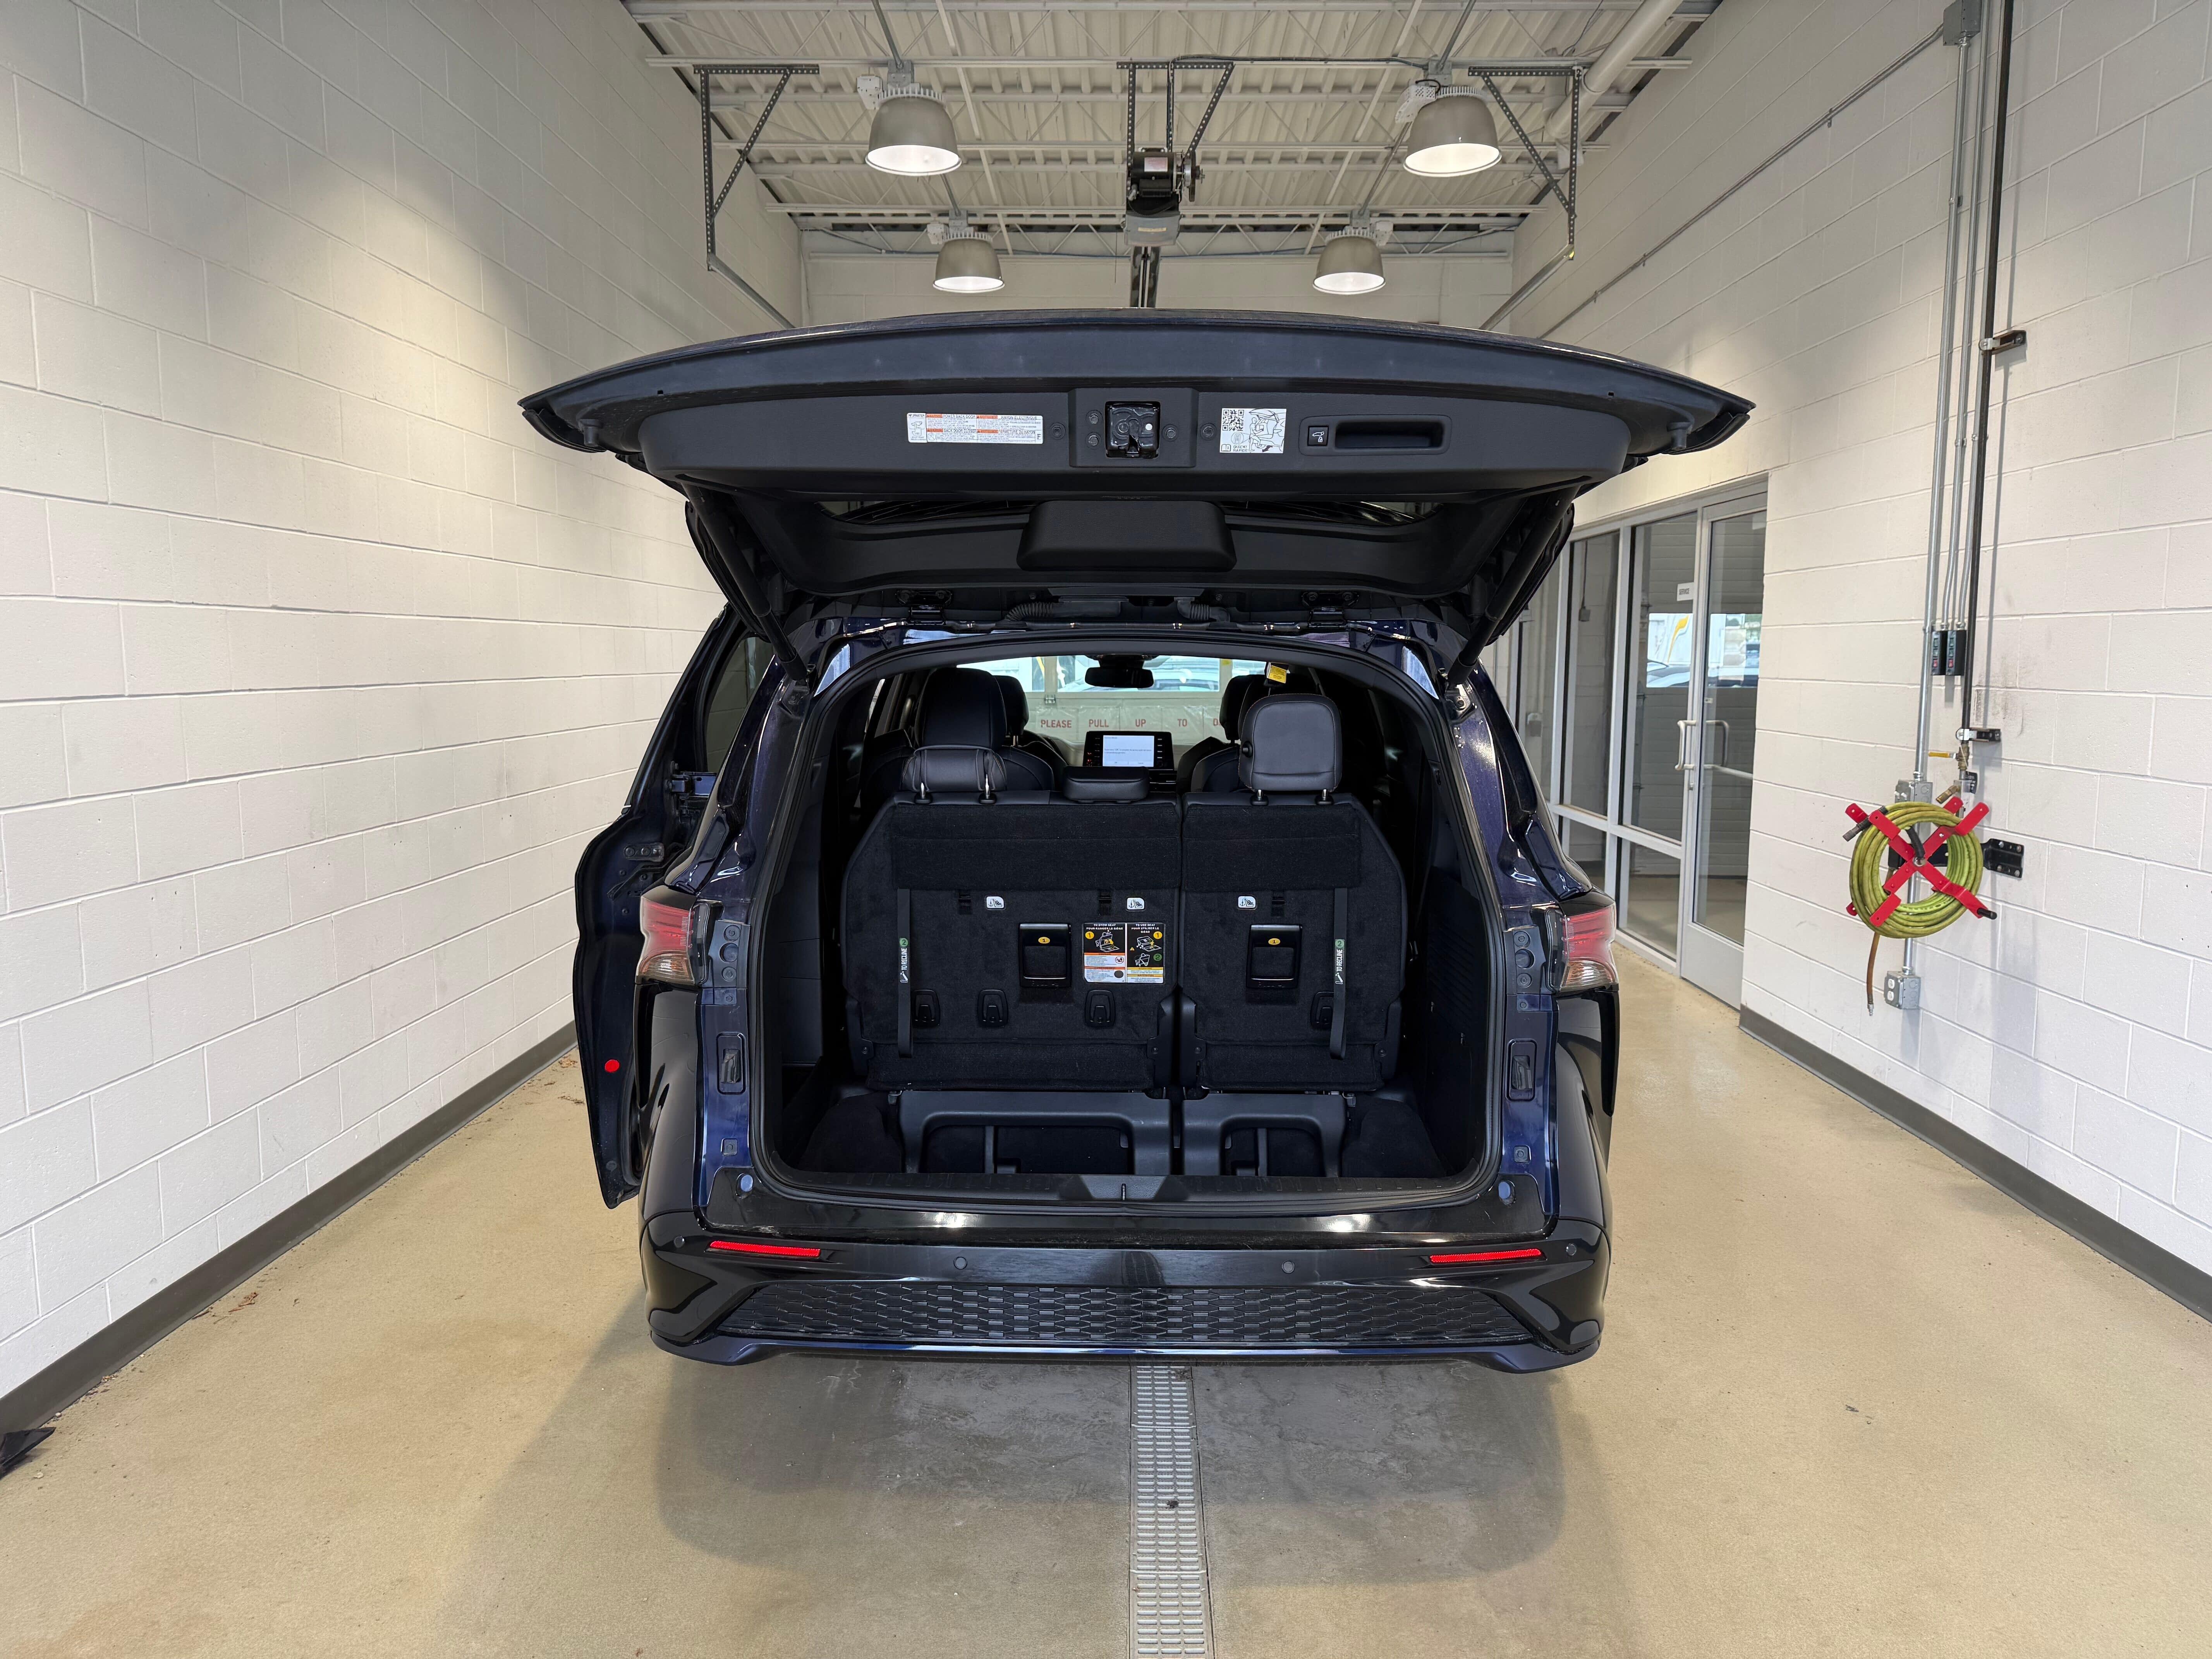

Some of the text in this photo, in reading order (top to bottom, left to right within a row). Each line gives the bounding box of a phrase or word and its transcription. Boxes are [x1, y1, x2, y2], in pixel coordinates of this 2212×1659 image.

[1041, 720, 1072, 728] PLEASE
[1089, 719, 1109, 727] PULL
[1135, 718, 1146, 727] UP
[1177, 718, 1188, 726] TO
